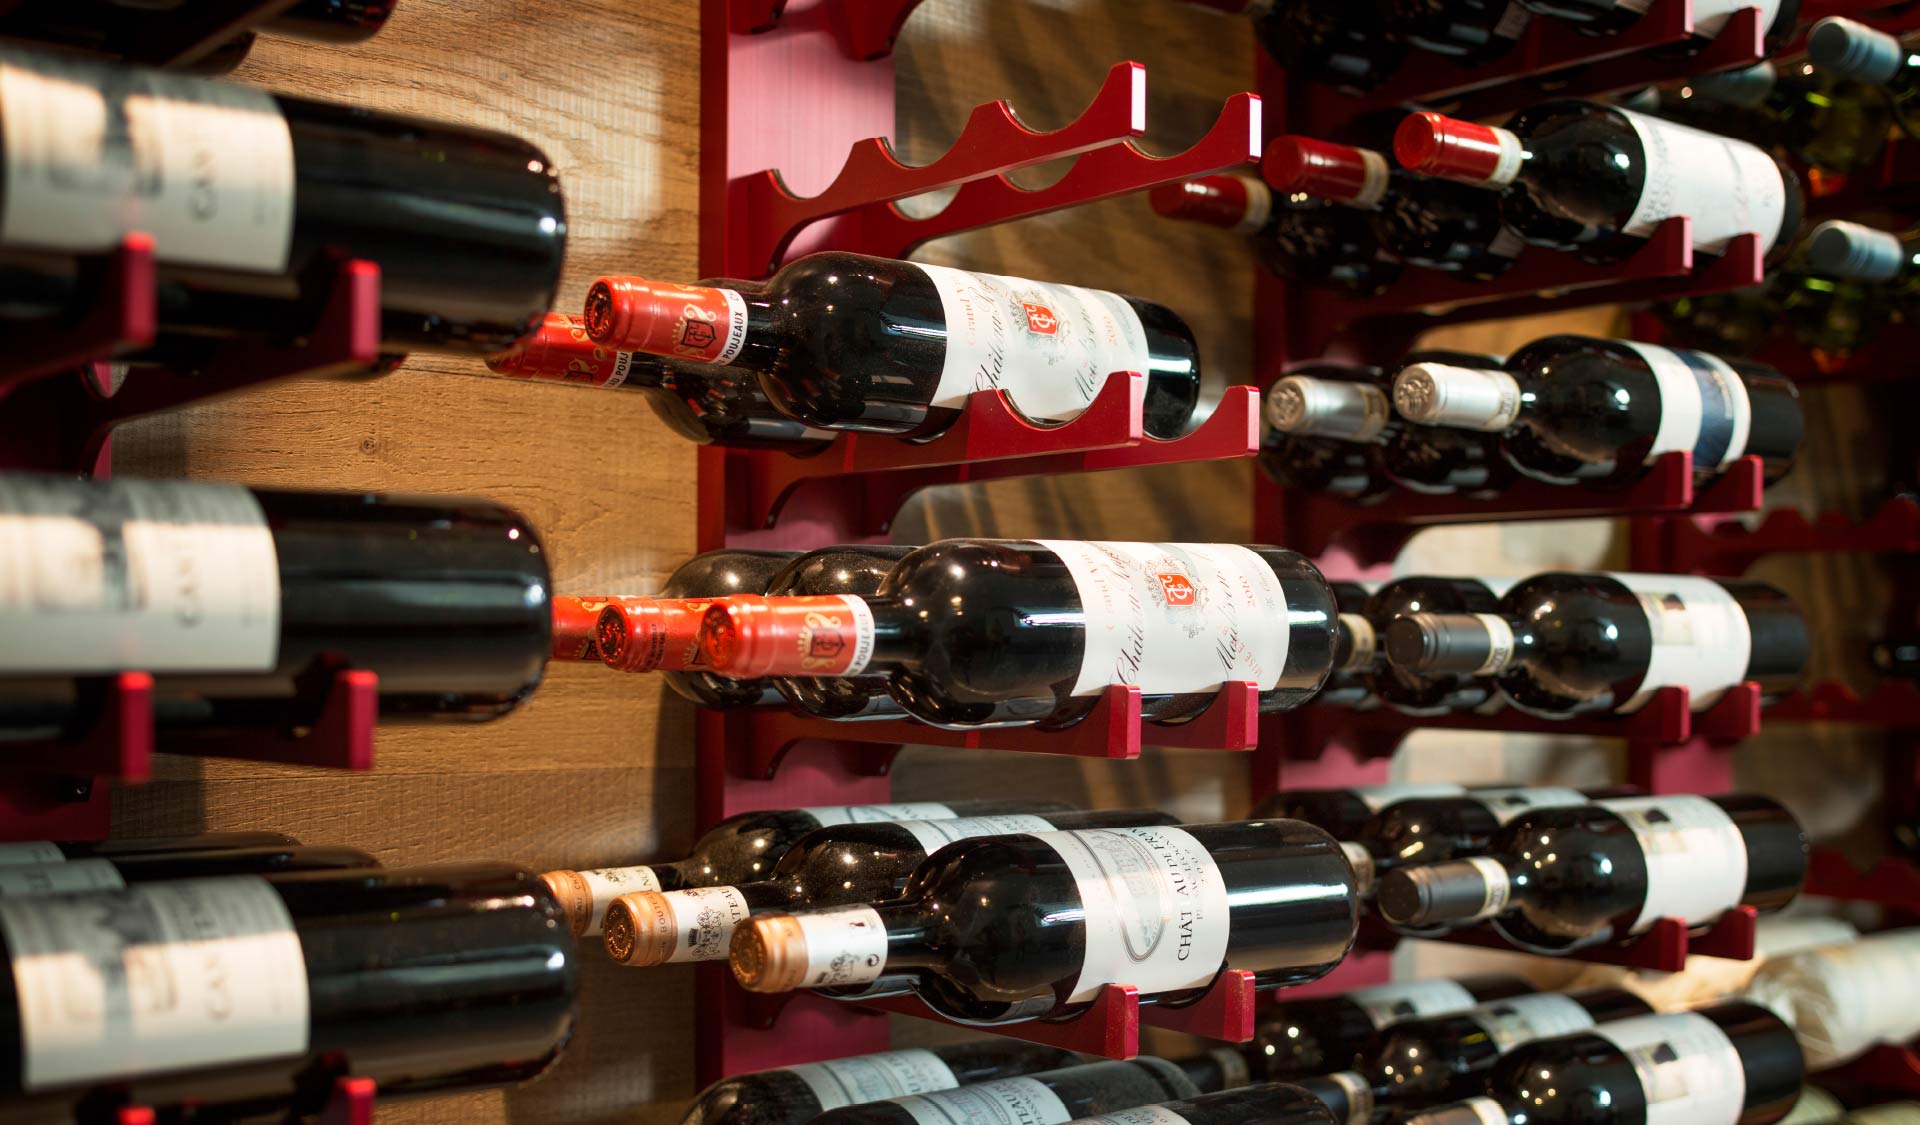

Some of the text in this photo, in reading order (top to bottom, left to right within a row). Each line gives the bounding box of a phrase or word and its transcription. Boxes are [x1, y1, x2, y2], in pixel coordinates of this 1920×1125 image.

[722, 311, 744, 360] POUJEAUX
[1240, 575, 1256, 607] 2010
[1162, 851, 1179, 868] DE
[1171, 873, 1193, 961] CHÂTAU
